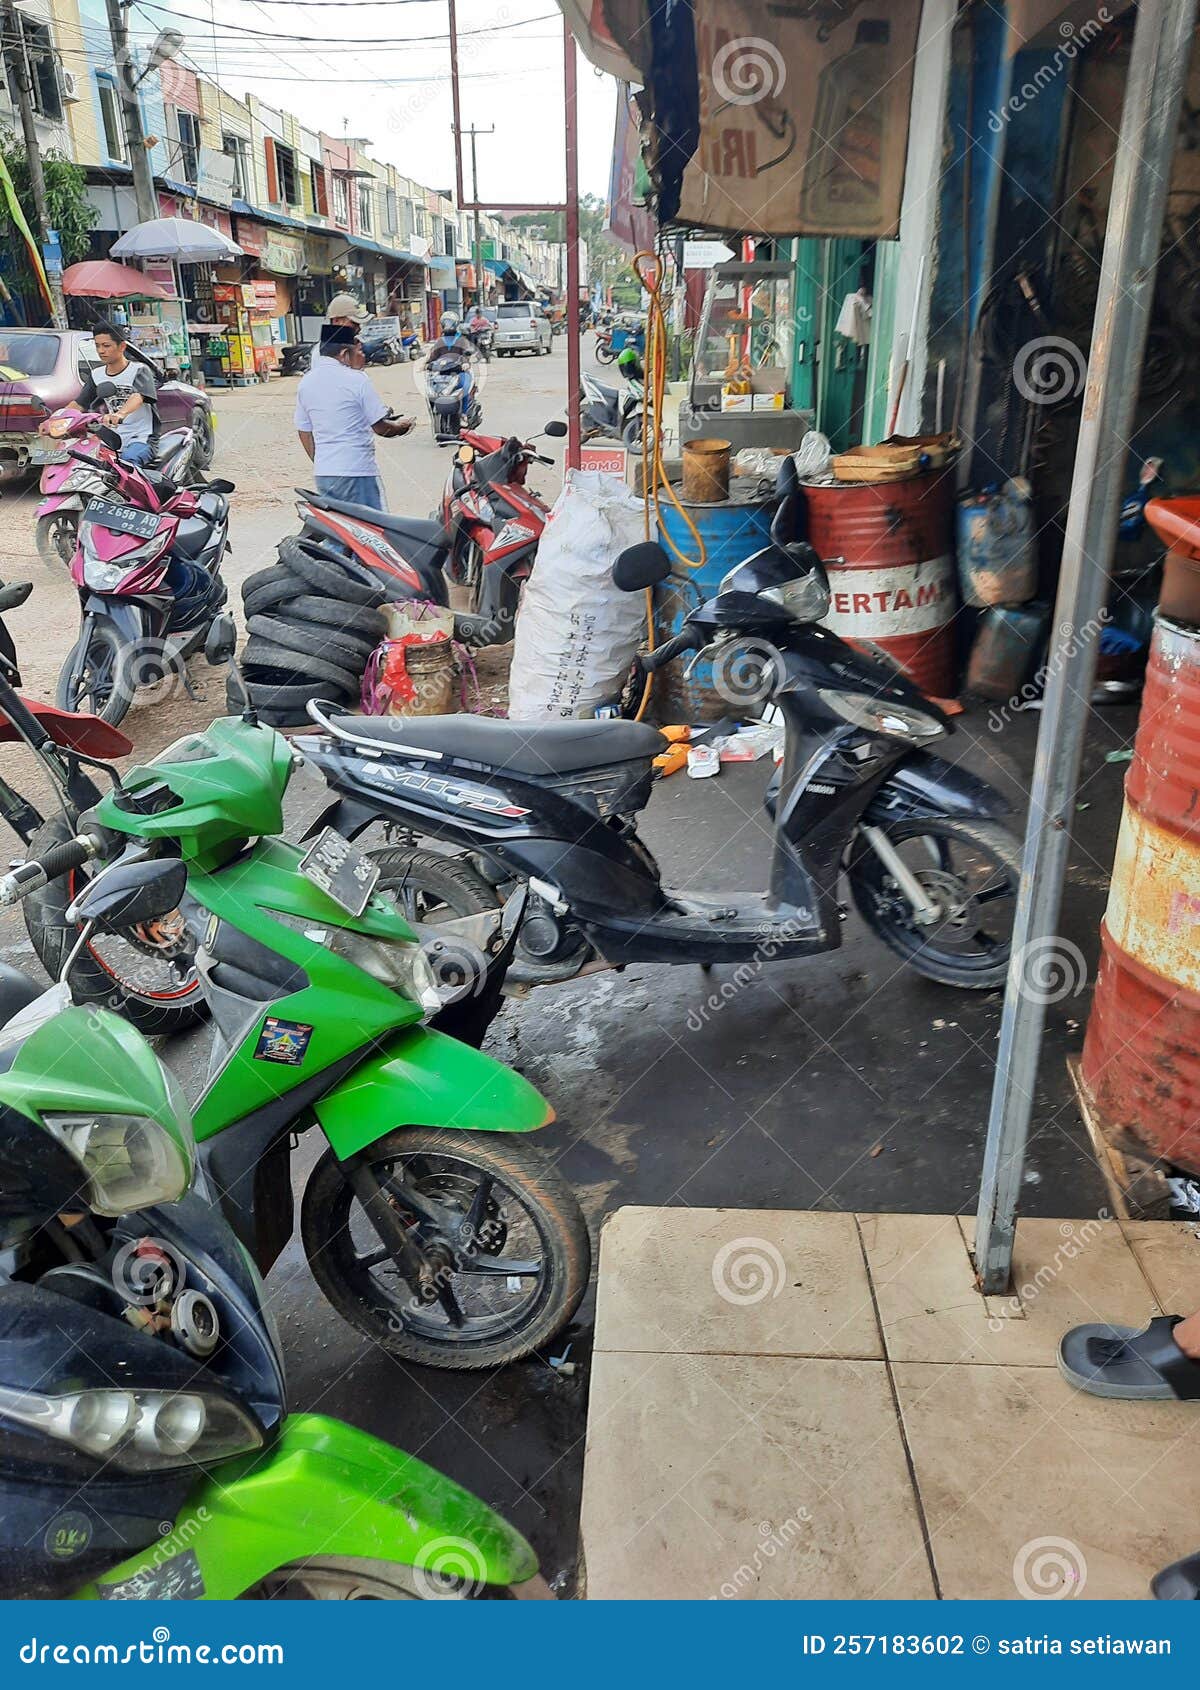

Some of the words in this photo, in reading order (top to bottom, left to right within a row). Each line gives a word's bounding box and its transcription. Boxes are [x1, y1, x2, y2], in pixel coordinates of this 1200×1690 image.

[581, 460, 621, 472] ROMO
[89, 500, 105, 512] BP
[829, 581, 938, 614] ERTAM
